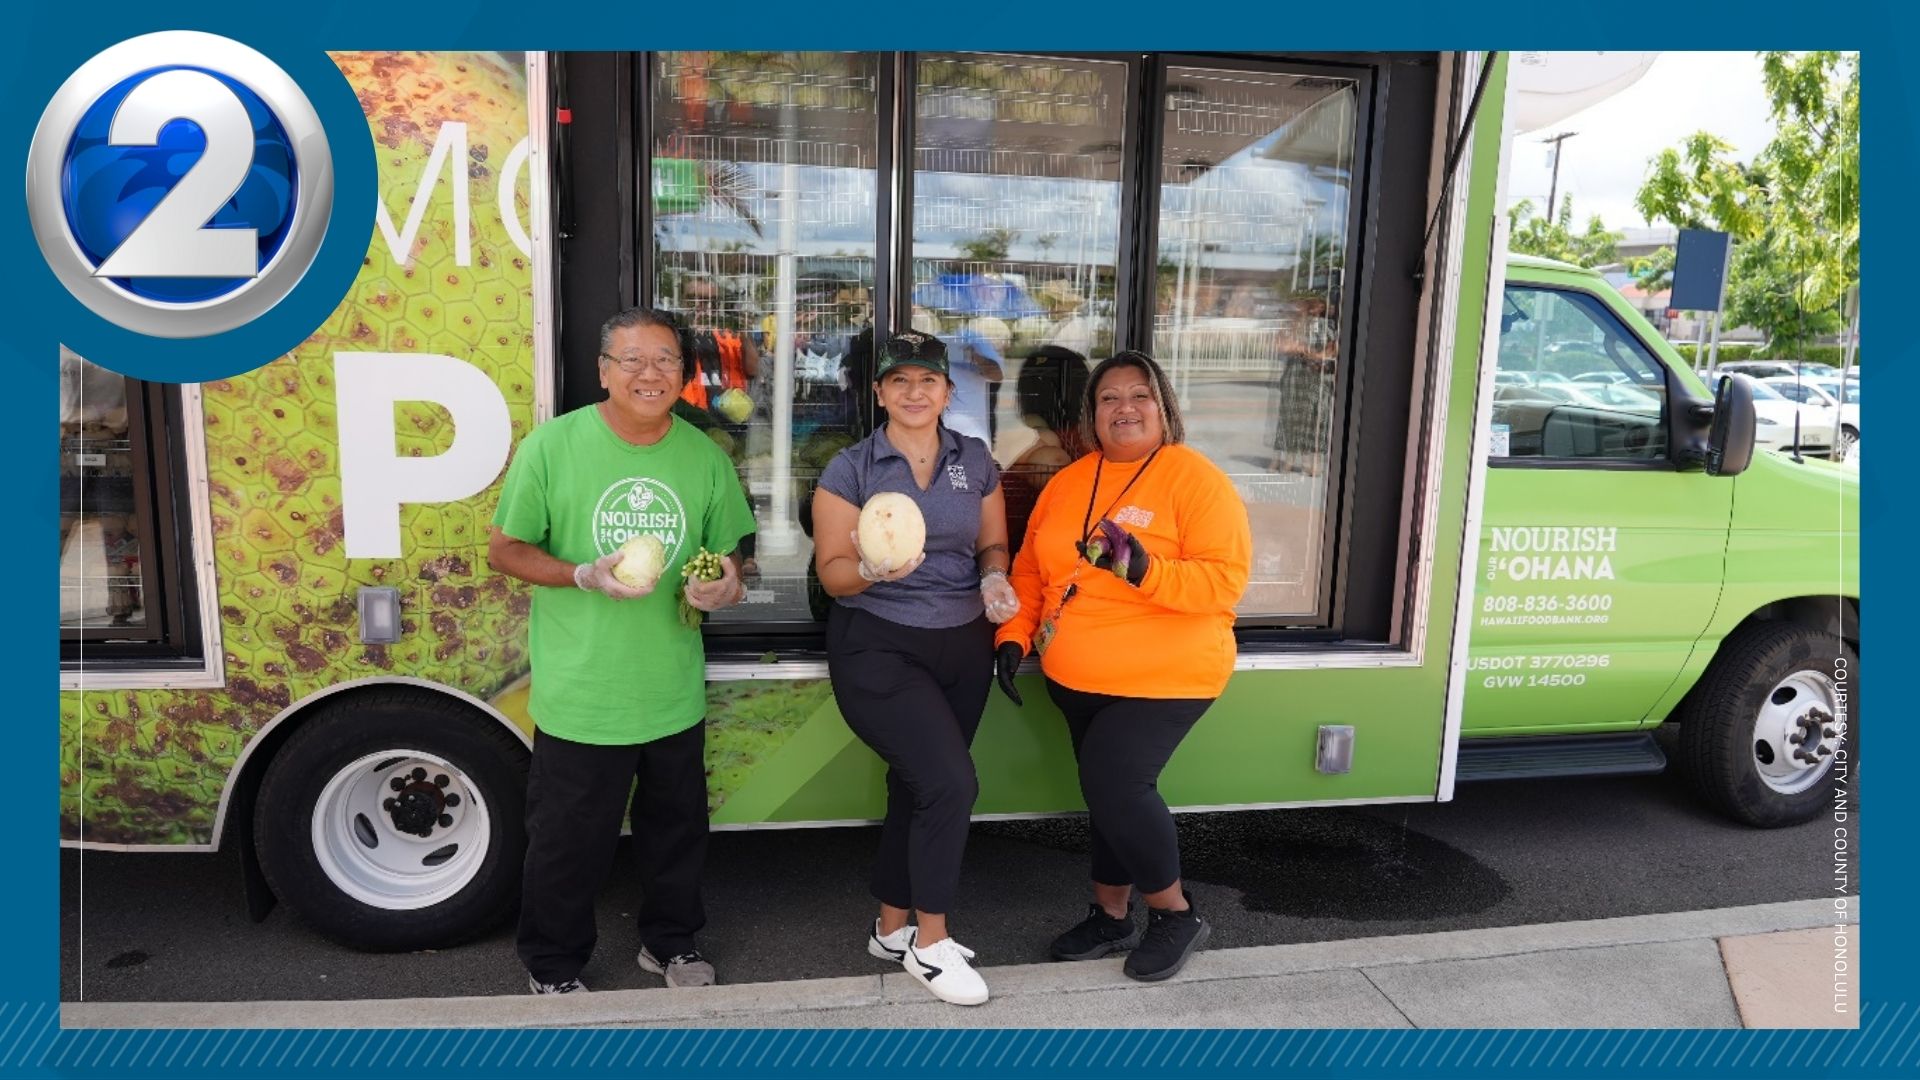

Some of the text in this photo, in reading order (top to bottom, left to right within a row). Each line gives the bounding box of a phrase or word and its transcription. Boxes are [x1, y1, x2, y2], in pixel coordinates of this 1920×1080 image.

[376, 121, 532, 269] M
[333, 351, 512, 560] P
[600, 511, 679, 528] NOURISH
[1489, 526, 1617, 552] NOURISH
[1486, 556, 1497, 581] OUR
[1483, 594, 1613, 612] 808-836-3600
[1480, 615, 1609, 626] HAWAIIFOODBANK.ORG
[1467, 654, 1610, 671] USDOT 3770296
[1483, 674, 1586, 689] GVW 14500
